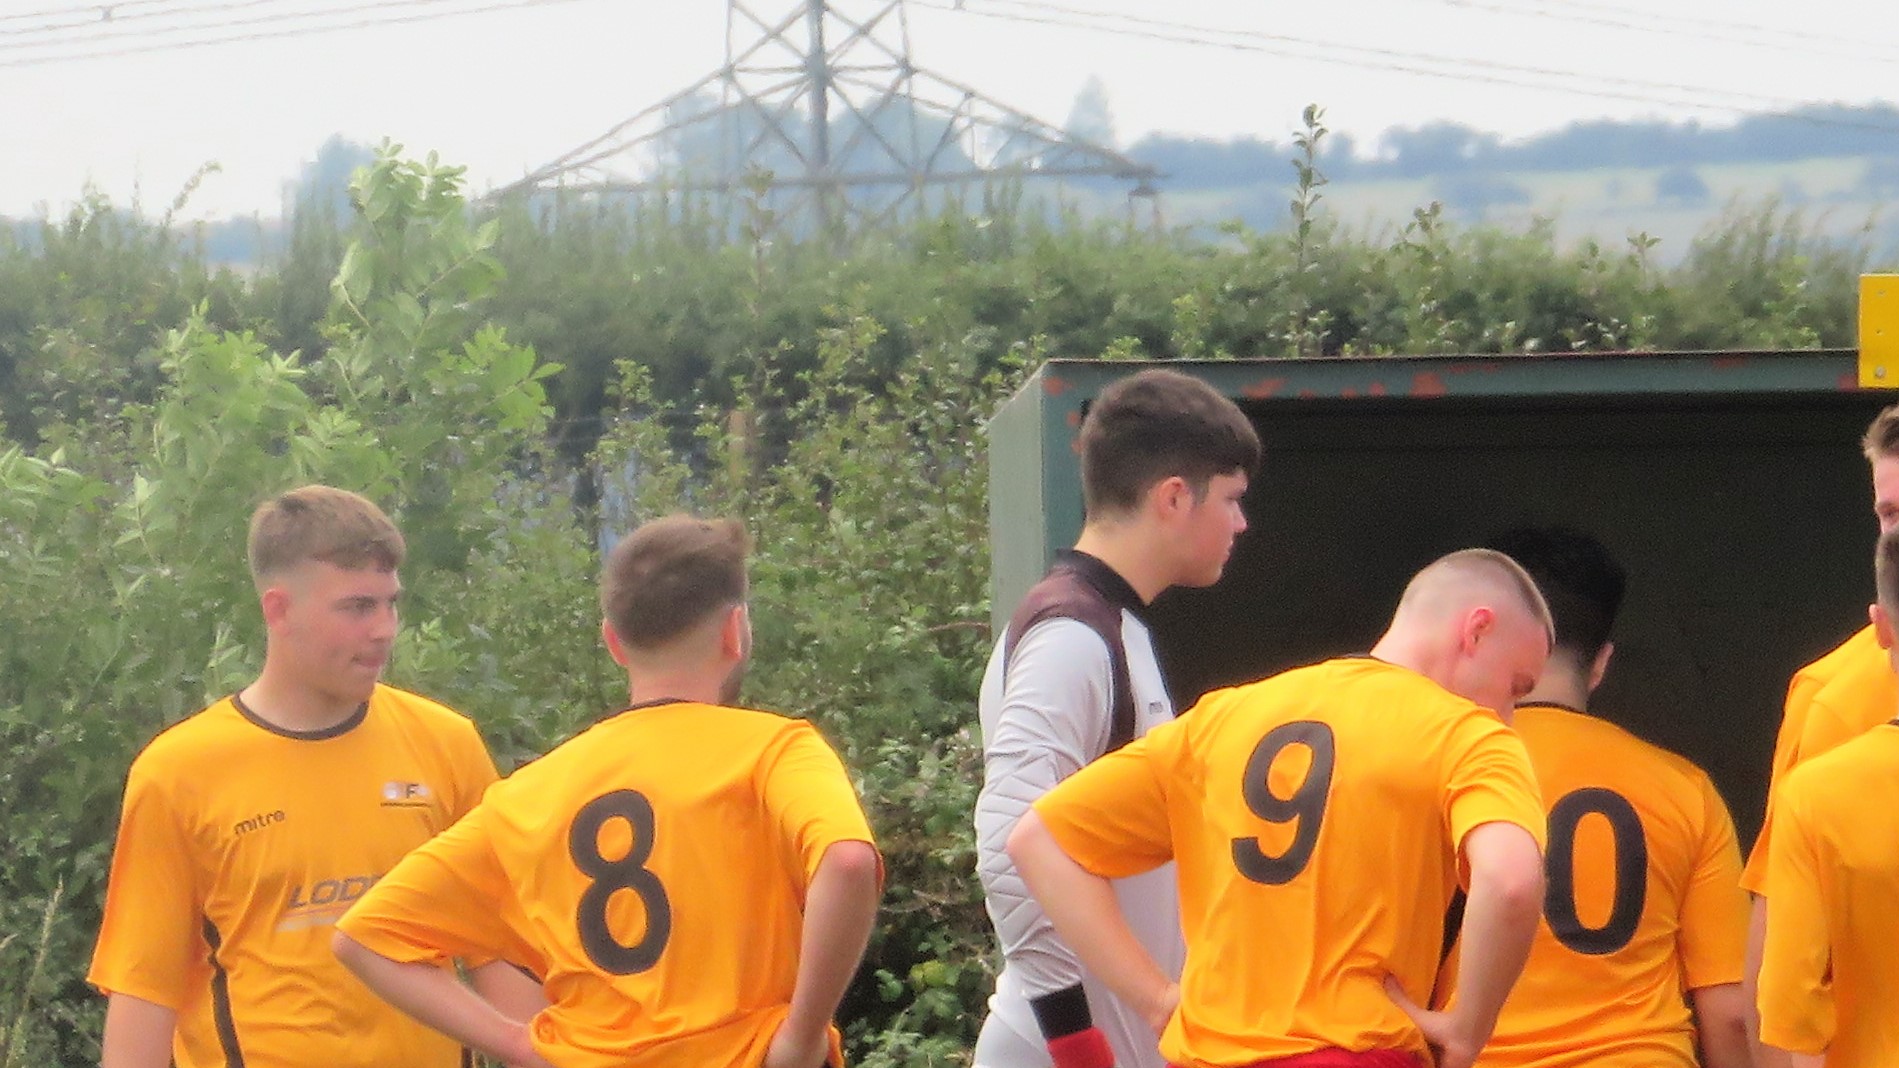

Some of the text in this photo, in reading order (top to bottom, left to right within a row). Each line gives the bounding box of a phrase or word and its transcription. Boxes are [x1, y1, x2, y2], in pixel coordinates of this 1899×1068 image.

[235, 810, 285, 834] mitre
[1232, 720, 1335, 885] 9
[288, 874, 382, 908] LOD
[568, 788, 672, 976] 8
